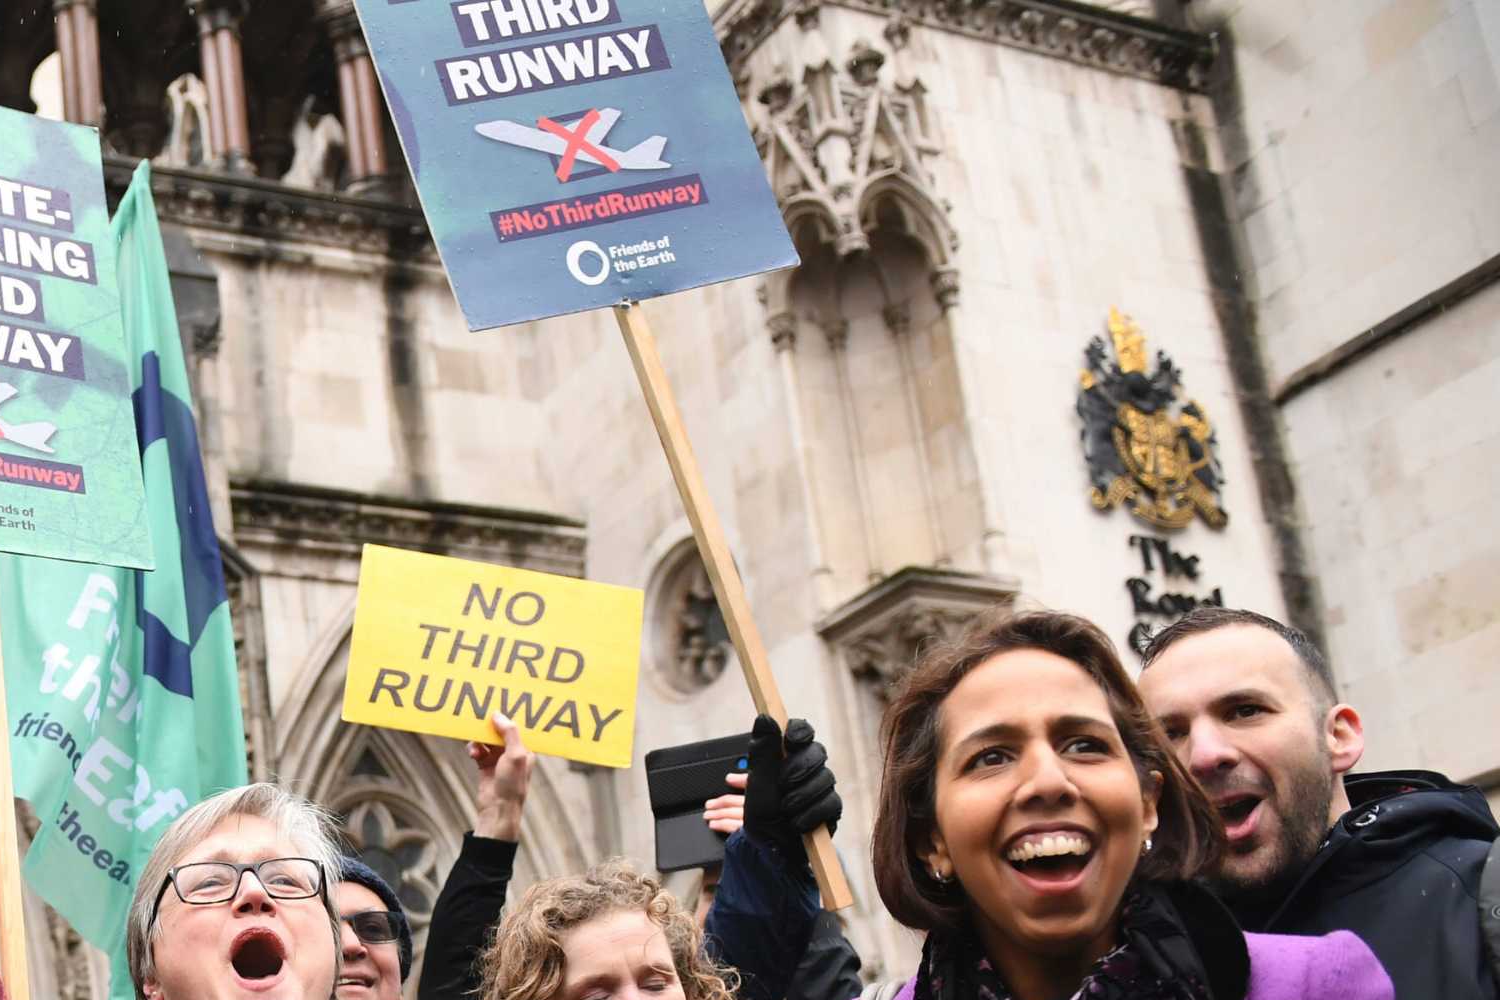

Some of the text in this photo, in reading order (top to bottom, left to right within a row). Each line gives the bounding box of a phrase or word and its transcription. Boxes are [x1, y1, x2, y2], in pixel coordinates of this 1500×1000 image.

[457, 0, 610, 41] THIRD
[446, 30, 651, 100] RUNWAY
[498, 183, 701, 236] #NoThirdRunway
[608, 236, 670, 260] Friends of
[614, 251, 676, 273] the Earth
[23, 505, 35, 518] of
[461, 583, 546, 627] NO
[419, 623, 586, 684] THIRD
[368, 668, 623, 742] RUNWAY
